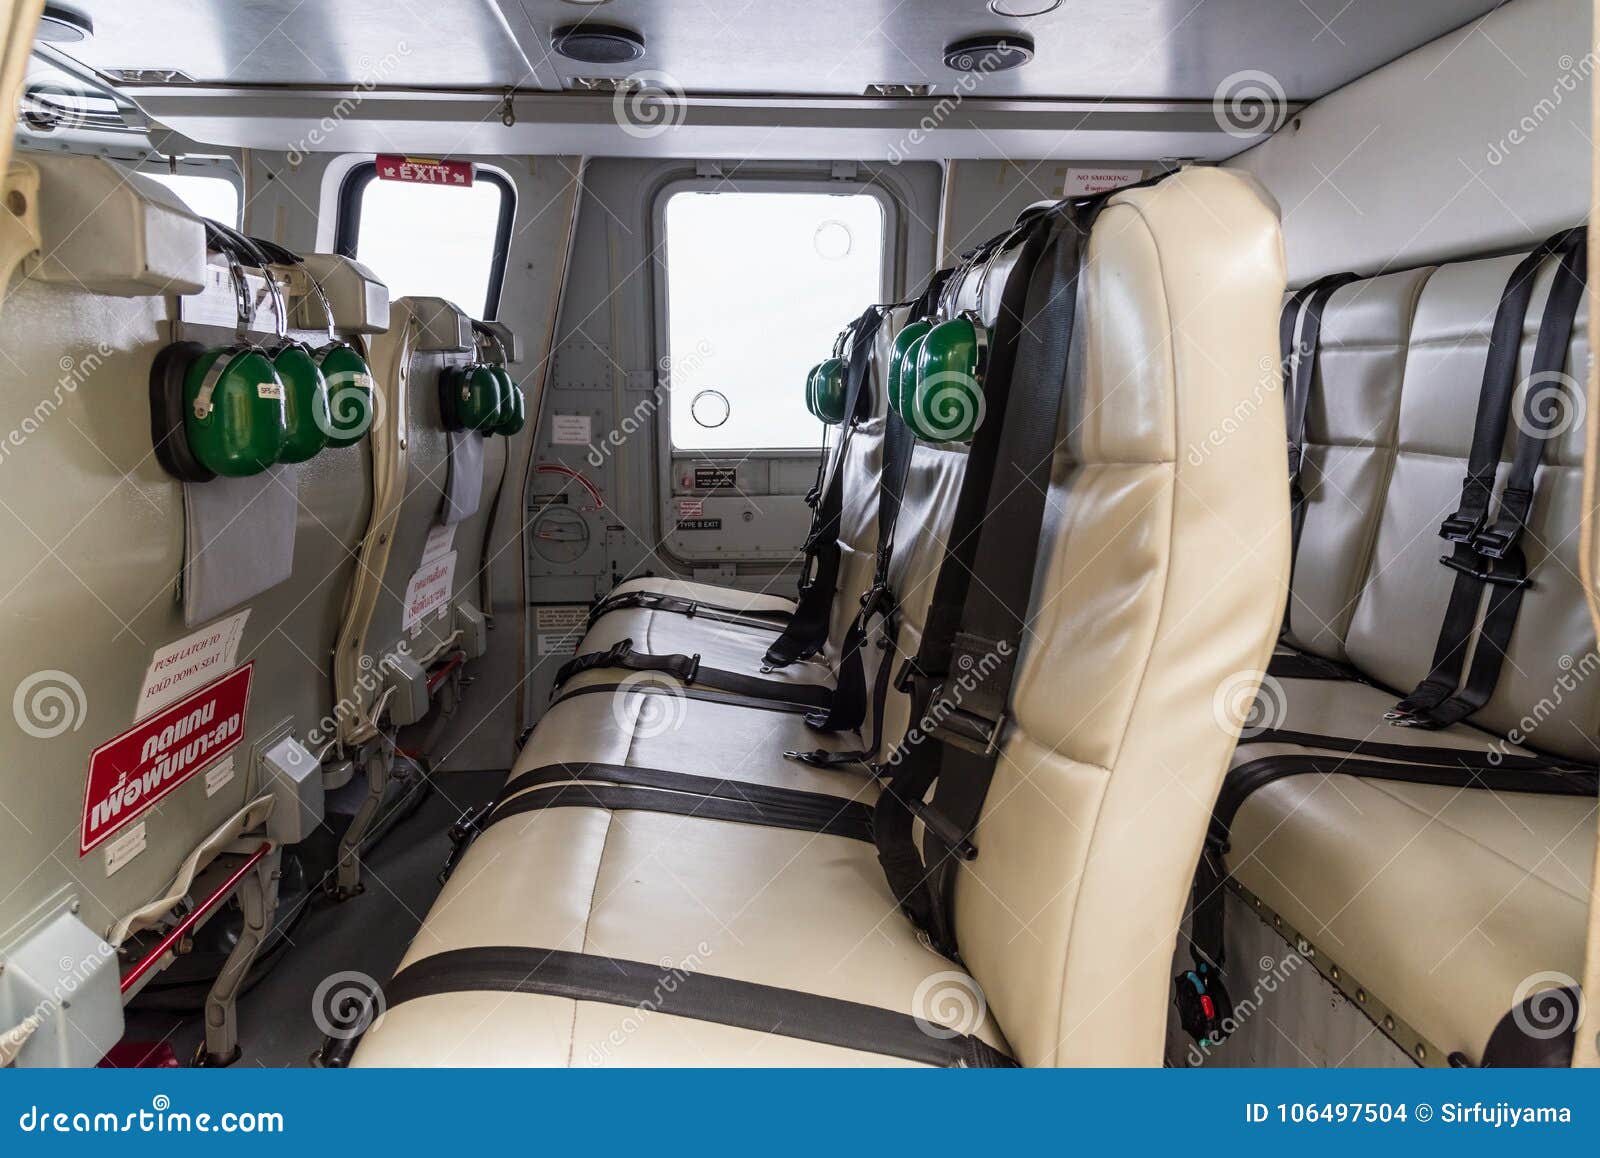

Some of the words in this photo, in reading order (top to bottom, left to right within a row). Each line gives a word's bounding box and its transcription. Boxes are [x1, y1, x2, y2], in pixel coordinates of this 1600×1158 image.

[400, 166, 449, 182] EXIT
[154, 653, 180, 672] PUSH
[180, 639, 208, 660] LATCH
[209, 633, 221, 646] TO
[146, 678, 171, 698] FOLD
[173, 665, 198, 684] DOWN
[200, 653, 220, 670] SEAT
[141, 699, 217, 764] กดแกน
[90, 713, 240, 832] เพื่อพับเบาะลง
